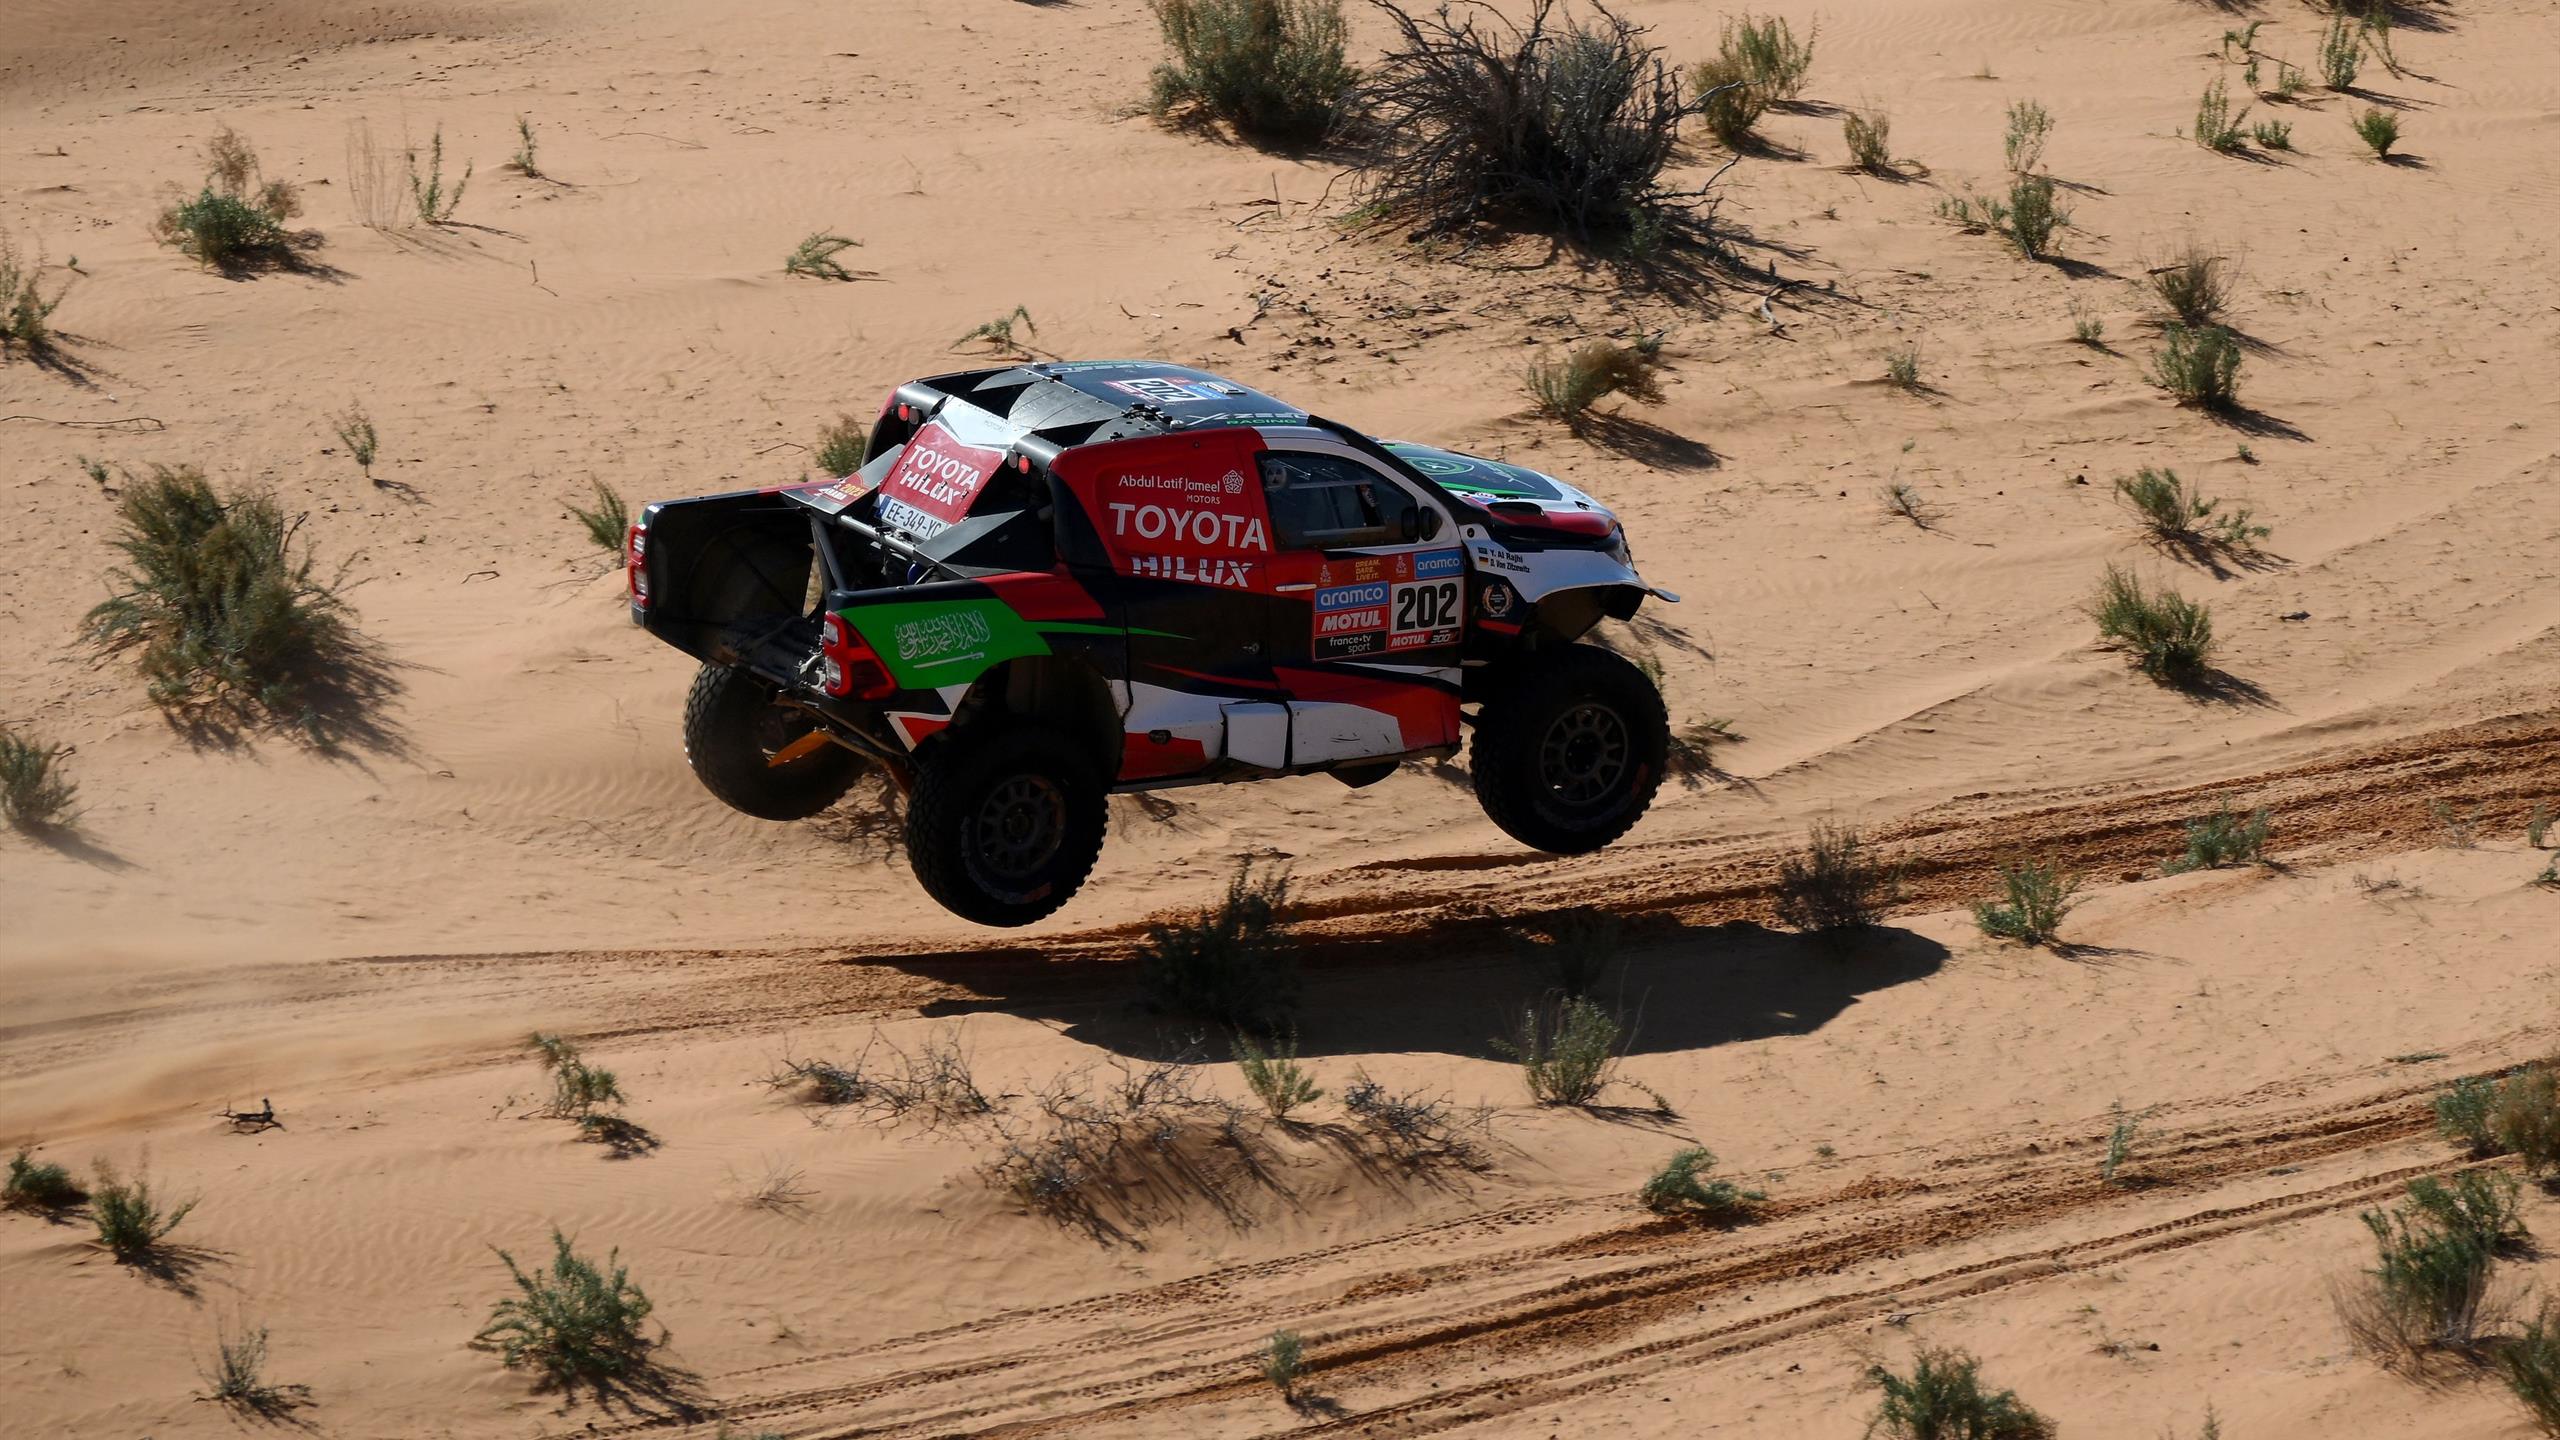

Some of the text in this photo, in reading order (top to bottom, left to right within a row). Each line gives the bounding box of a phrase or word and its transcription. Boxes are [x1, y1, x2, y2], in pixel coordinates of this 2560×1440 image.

[907, 444, 981, 491] TOYOTA
[839, 483, 865, 497] 2023
[899, 470, 962, 506] HILUX
[1118, 475, 1220, 493] Abdul Latif Jameel
[1186, 494, 1220, 505] MOTORS
[1109, 502, 1268, 551] TOYOTA
[1417, 557, 1460, 571] aramco
[1506, 553, 1523, 563] Rajhi
[1131, 556, 1253, 588] HILUX
[1320, 587, 1384, 606] aramco
[1396, 582, 1458, 631] 202
[1321, 610, 1382, 632] MOTUL
[1348, 643, 1371, 655] sport
[1391, 634, 1426, 647] MOTUL
